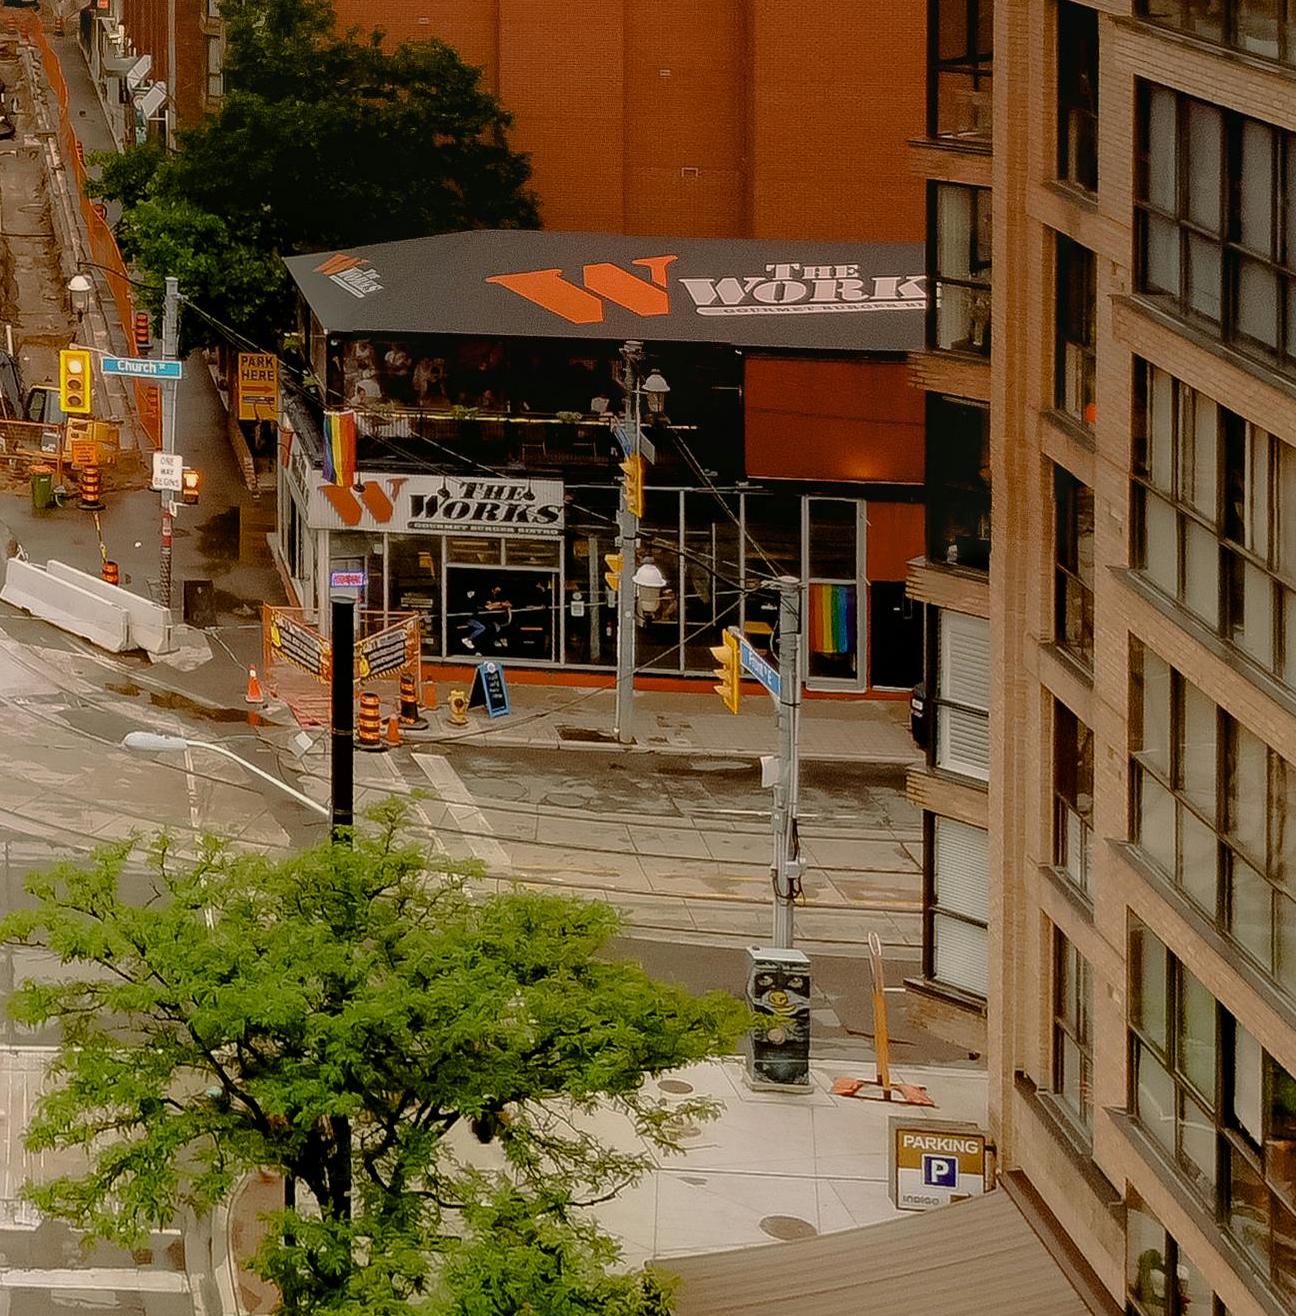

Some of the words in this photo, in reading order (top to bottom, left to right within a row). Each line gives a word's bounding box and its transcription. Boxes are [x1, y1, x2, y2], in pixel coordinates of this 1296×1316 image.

[765, 263, 859, 281] THE
[679, 276, 926, 306] WORK
[117, 359, 156, 374] Church
[241, 355, 274, 369] PARK
[241, 369, 275, 382] HERE
[459, 482, 526, 502] THE
[409, 494, 564, 525] WORKS
[414, 521, 469, 532] GOURMET
[470, 524, 516, 534] BURGER
[517, 526, 559, 536] BISTRO
[903, 1134, 979, 1154] PARKING
[902, 1195, 940, 1206] INDIGO
